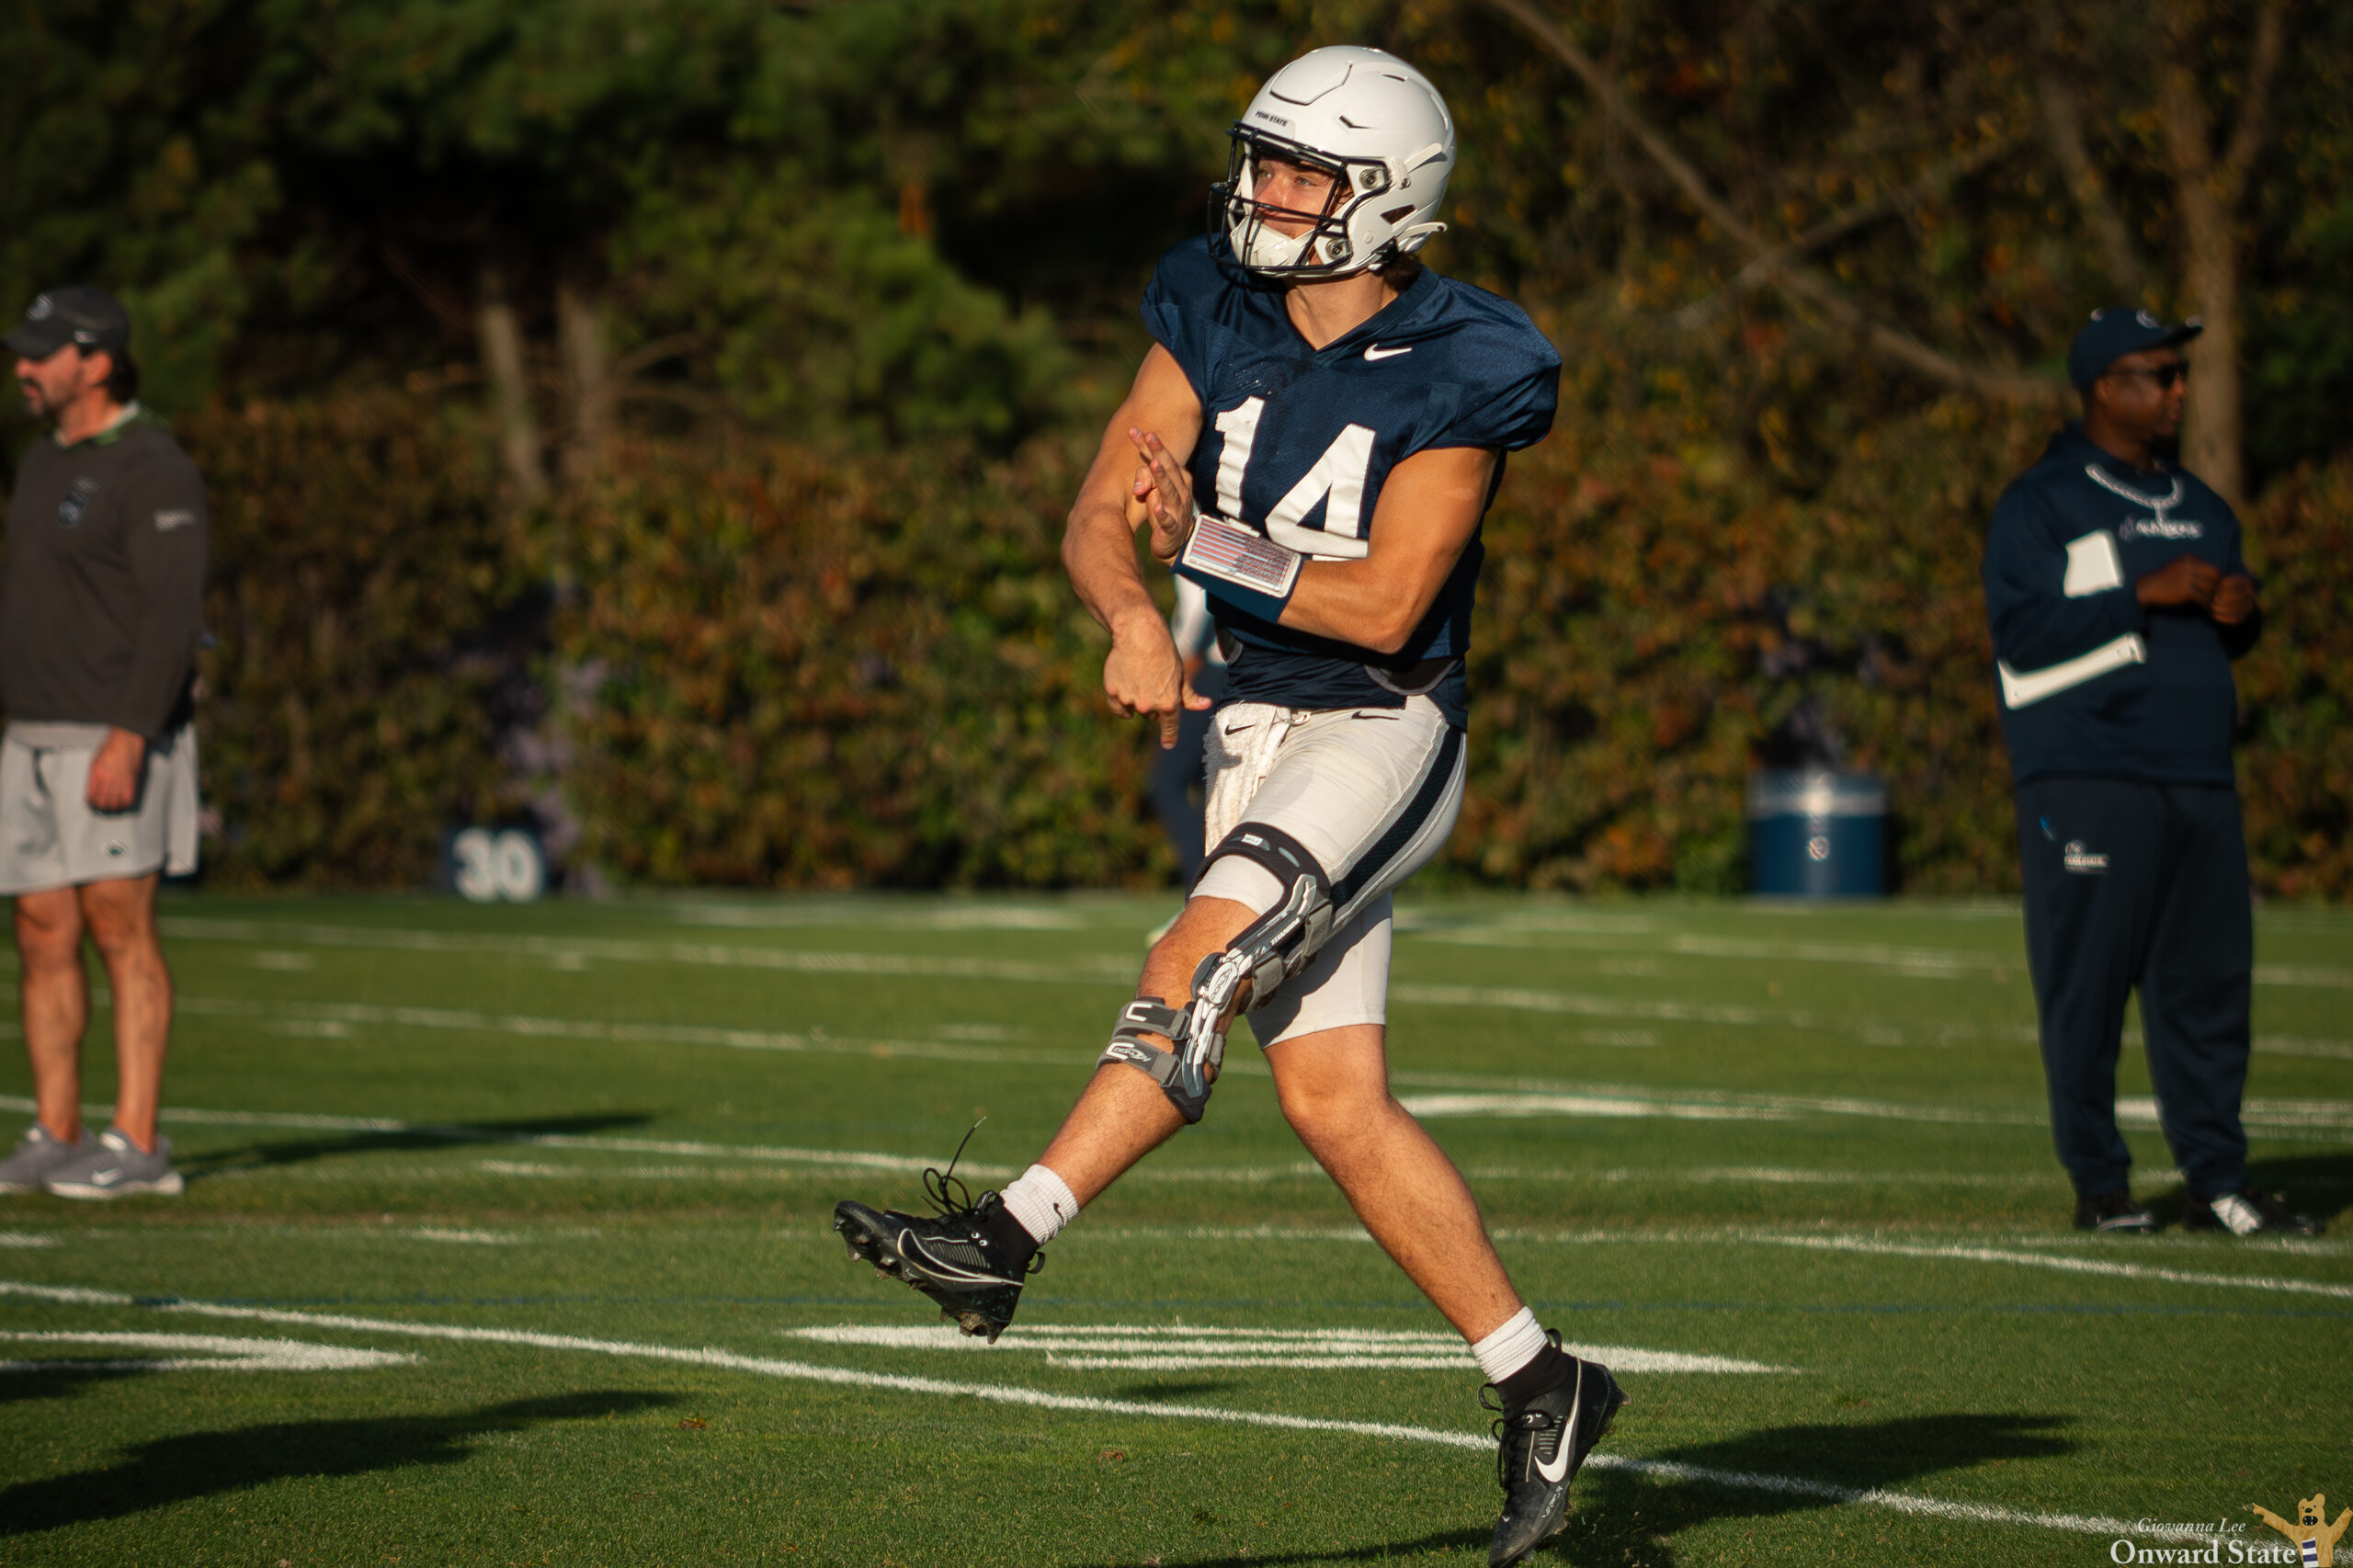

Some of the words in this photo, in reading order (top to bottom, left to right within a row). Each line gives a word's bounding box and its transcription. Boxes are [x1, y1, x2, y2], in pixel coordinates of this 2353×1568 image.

[1256, 110, 1269, 120] PENN
[1268, 116, 1288, 127] STATE
[1214, 395, 1376, 558] 14
[452, 827, 541, 903] 30
